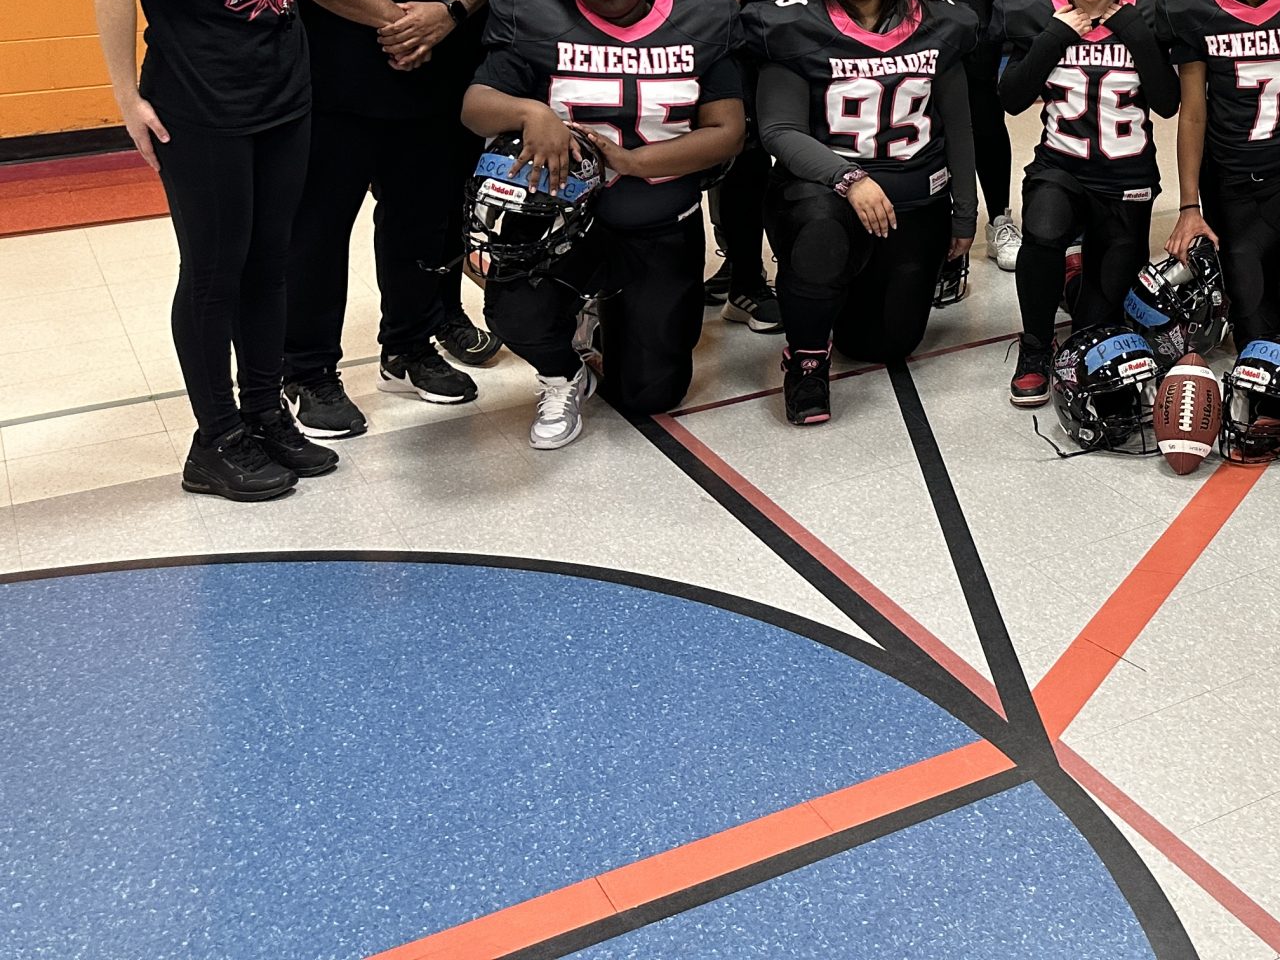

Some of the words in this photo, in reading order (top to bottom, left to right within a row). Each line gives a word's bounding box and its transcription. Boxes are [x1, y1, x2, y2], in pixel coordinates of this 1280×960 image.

[556, 41, 695, 75] RENEGADES
[828, 49, 940, 79] RENEGADES
[1044, 65, 1148, 161] 26
[1163, 382, 1178, 425] Wilson
[1200, 389, 1213, 431] Wilson
